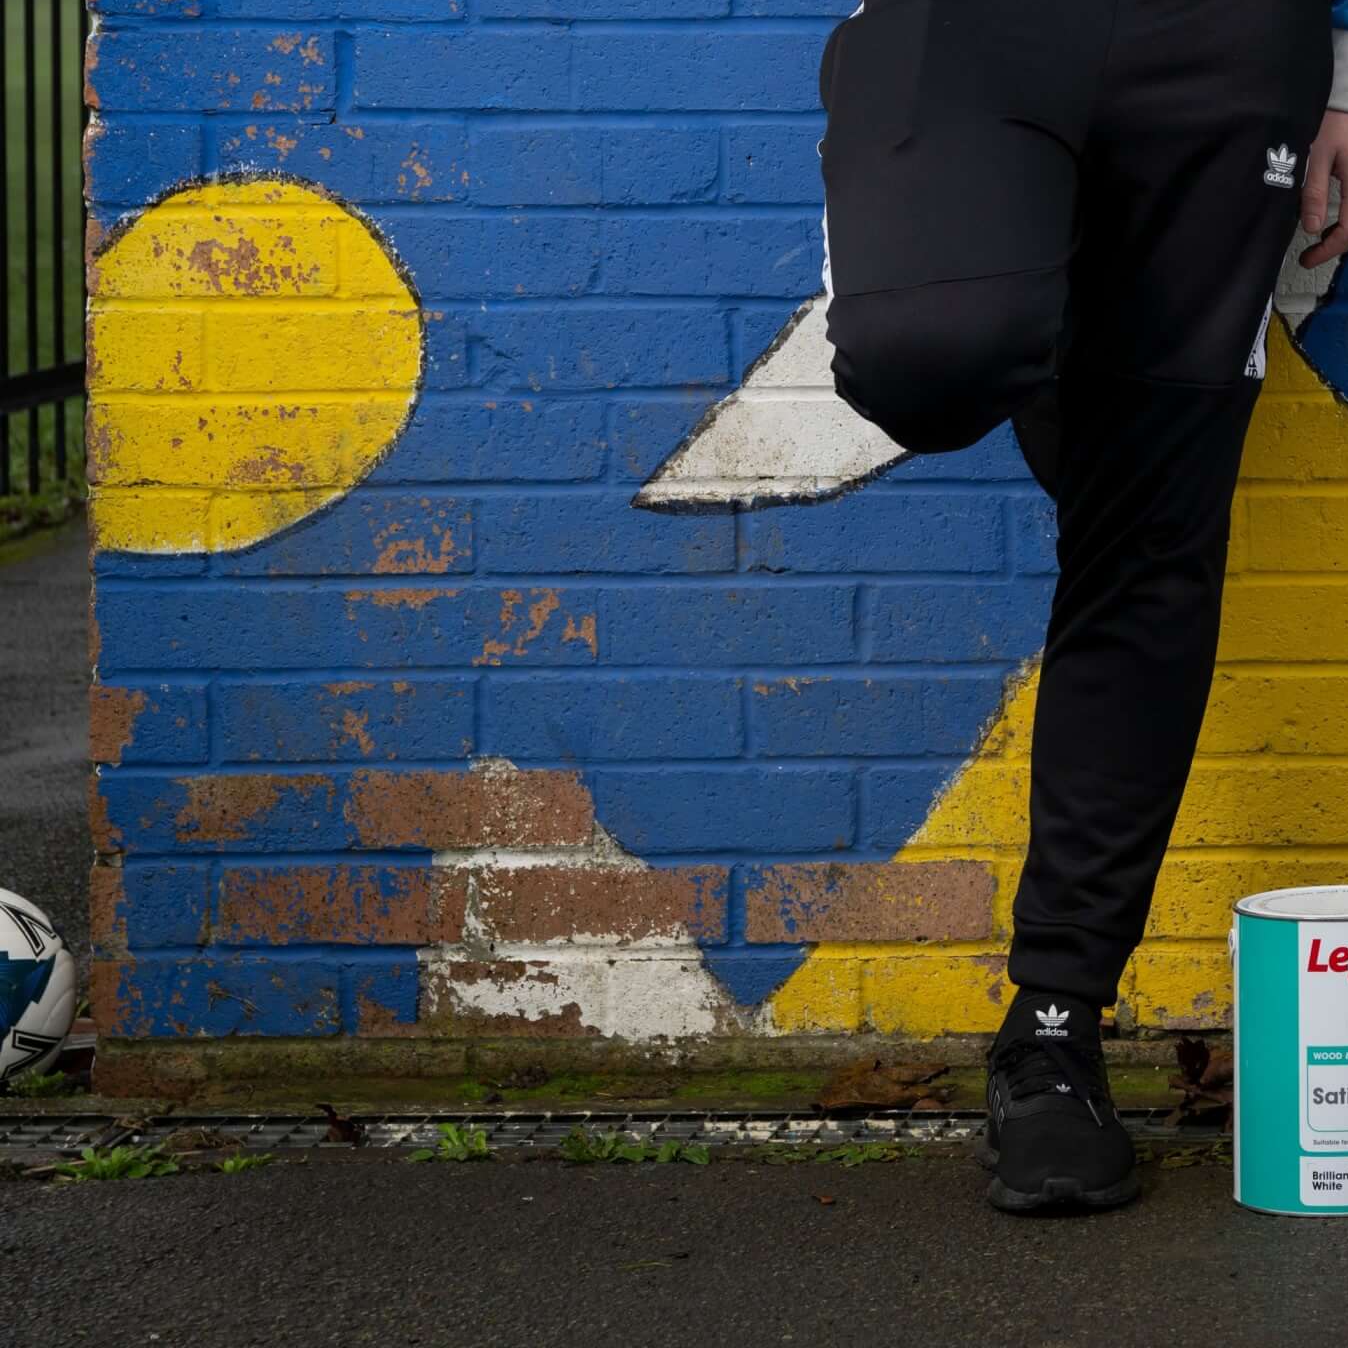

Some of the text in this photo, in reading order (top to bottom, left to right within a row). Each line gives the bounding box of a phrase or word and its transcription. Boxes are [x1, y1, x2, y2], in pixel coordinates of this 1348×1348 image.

[1266, 172, 1293, 185] adidas
[1035, 1027, 1069, 1037] adidas
[1313, 1052, 1343, 1060] WOOD
[1312, 1181, 1343, 1192] White
